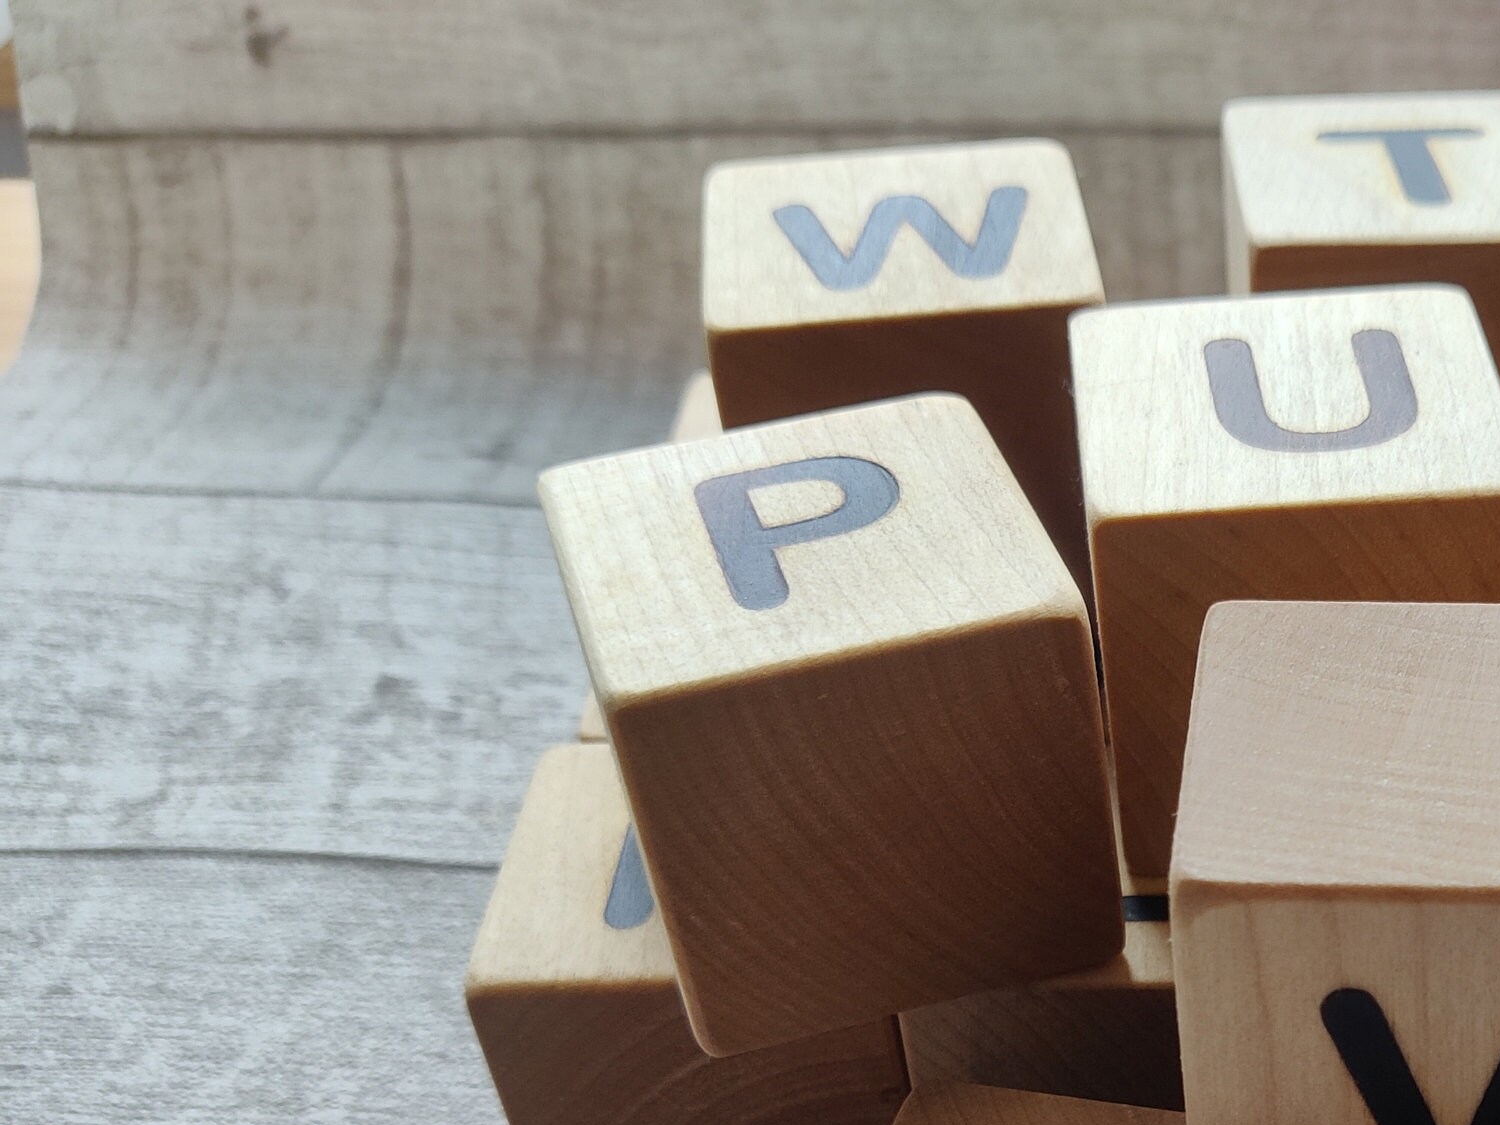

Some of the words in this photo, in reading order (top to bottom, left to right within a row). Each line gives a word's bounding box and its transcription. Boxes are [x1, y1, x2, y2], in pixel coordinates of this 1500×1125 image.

[1315, 127, 1485, 206] T
[772, 185, 1029, 291] W
[1203, 329, 1419, 453] U
[693, 456, 900, 611] P
